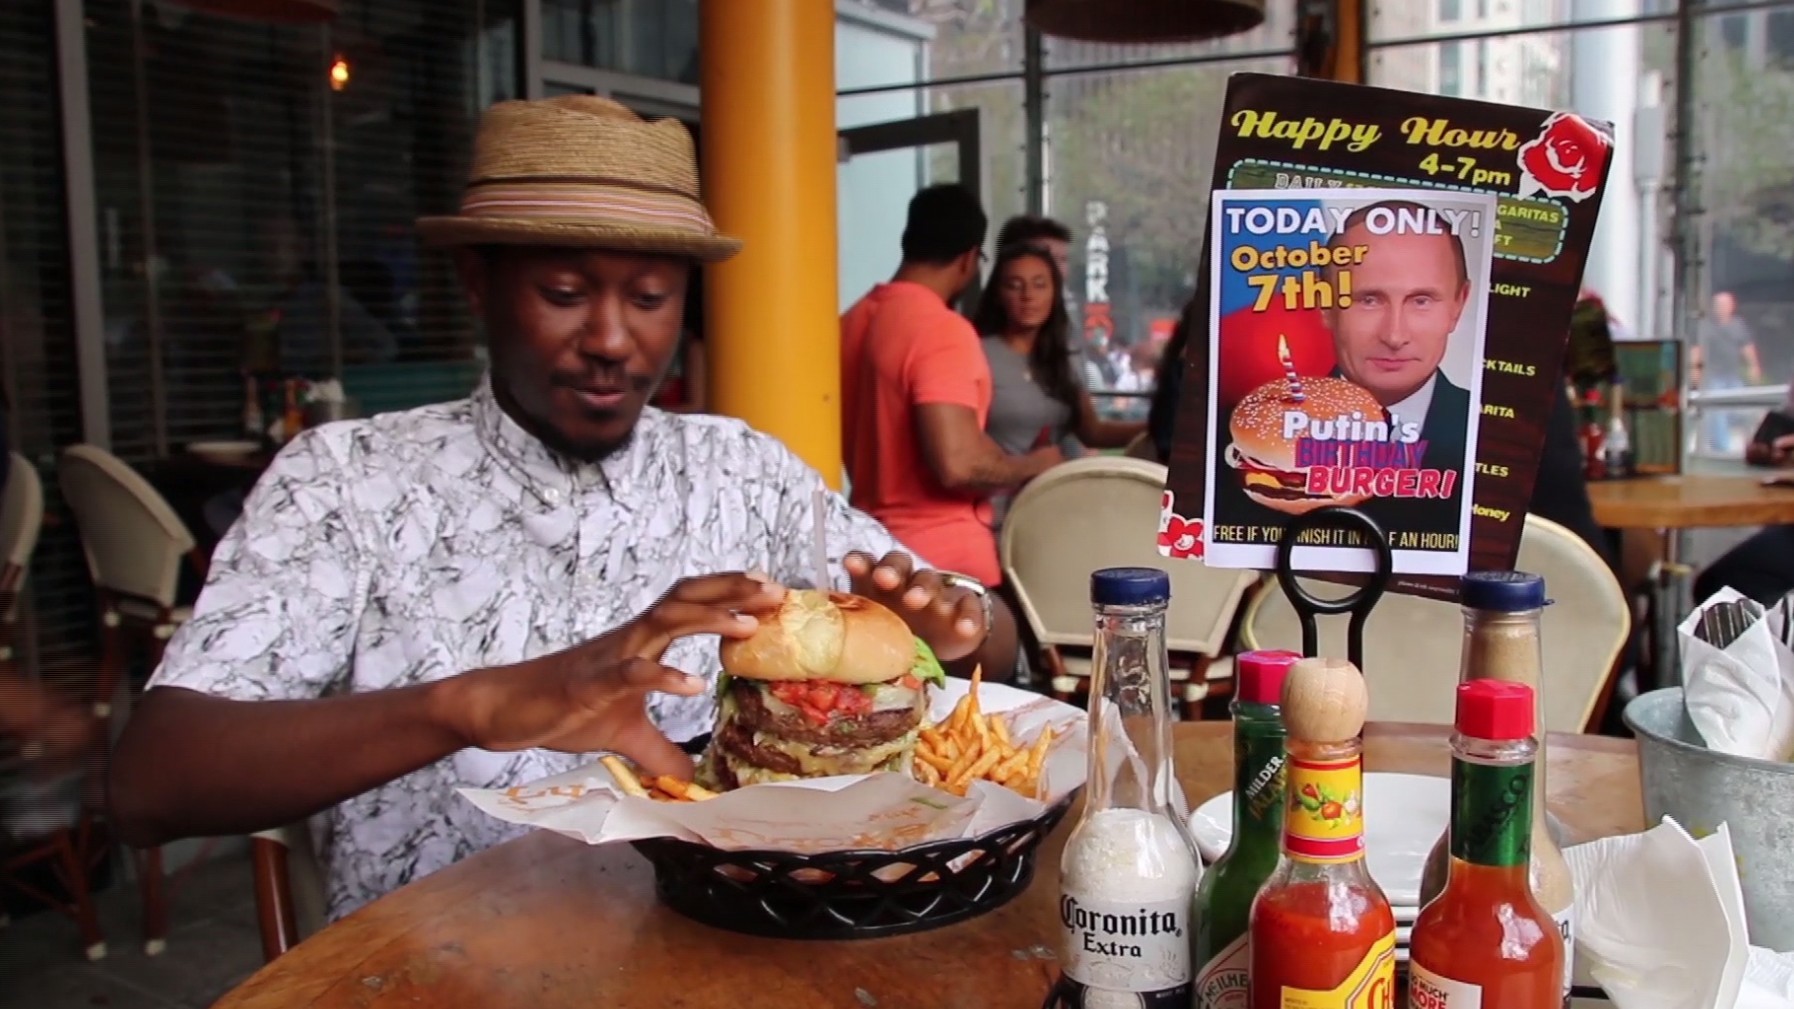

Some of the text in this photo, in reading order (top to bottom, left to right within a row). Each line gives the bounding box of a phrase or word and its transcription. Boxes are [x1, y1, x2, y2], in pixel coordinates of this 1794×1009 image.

[1231, 109, 1521, 152] Happy Hour
[1419, 153, 1511, 186] 4-7pm
[1226, 207, 1481, 238] TODAY ONLY!
[1231, 241, 1369, 272] October
[1248, 270, 1353, 312] 7th!
[1283, 411, 1420, 443] Putin's
[1294, 437, 1429, 469] BIRTHDAY
[1306, 465, 1457, 500] BURGER!
[1213, 525, 1244, 541] FREE
[1247, 526, 1259, 541] IF
[1333, 529, 1345, 544] IT
[1400, 532, 1418, 547] AN
[1421, 533, 1459, 549] HOUR!
[1060, 894, 1178, 936] Coronita
[1083, 931, 1142, 957] Extra
